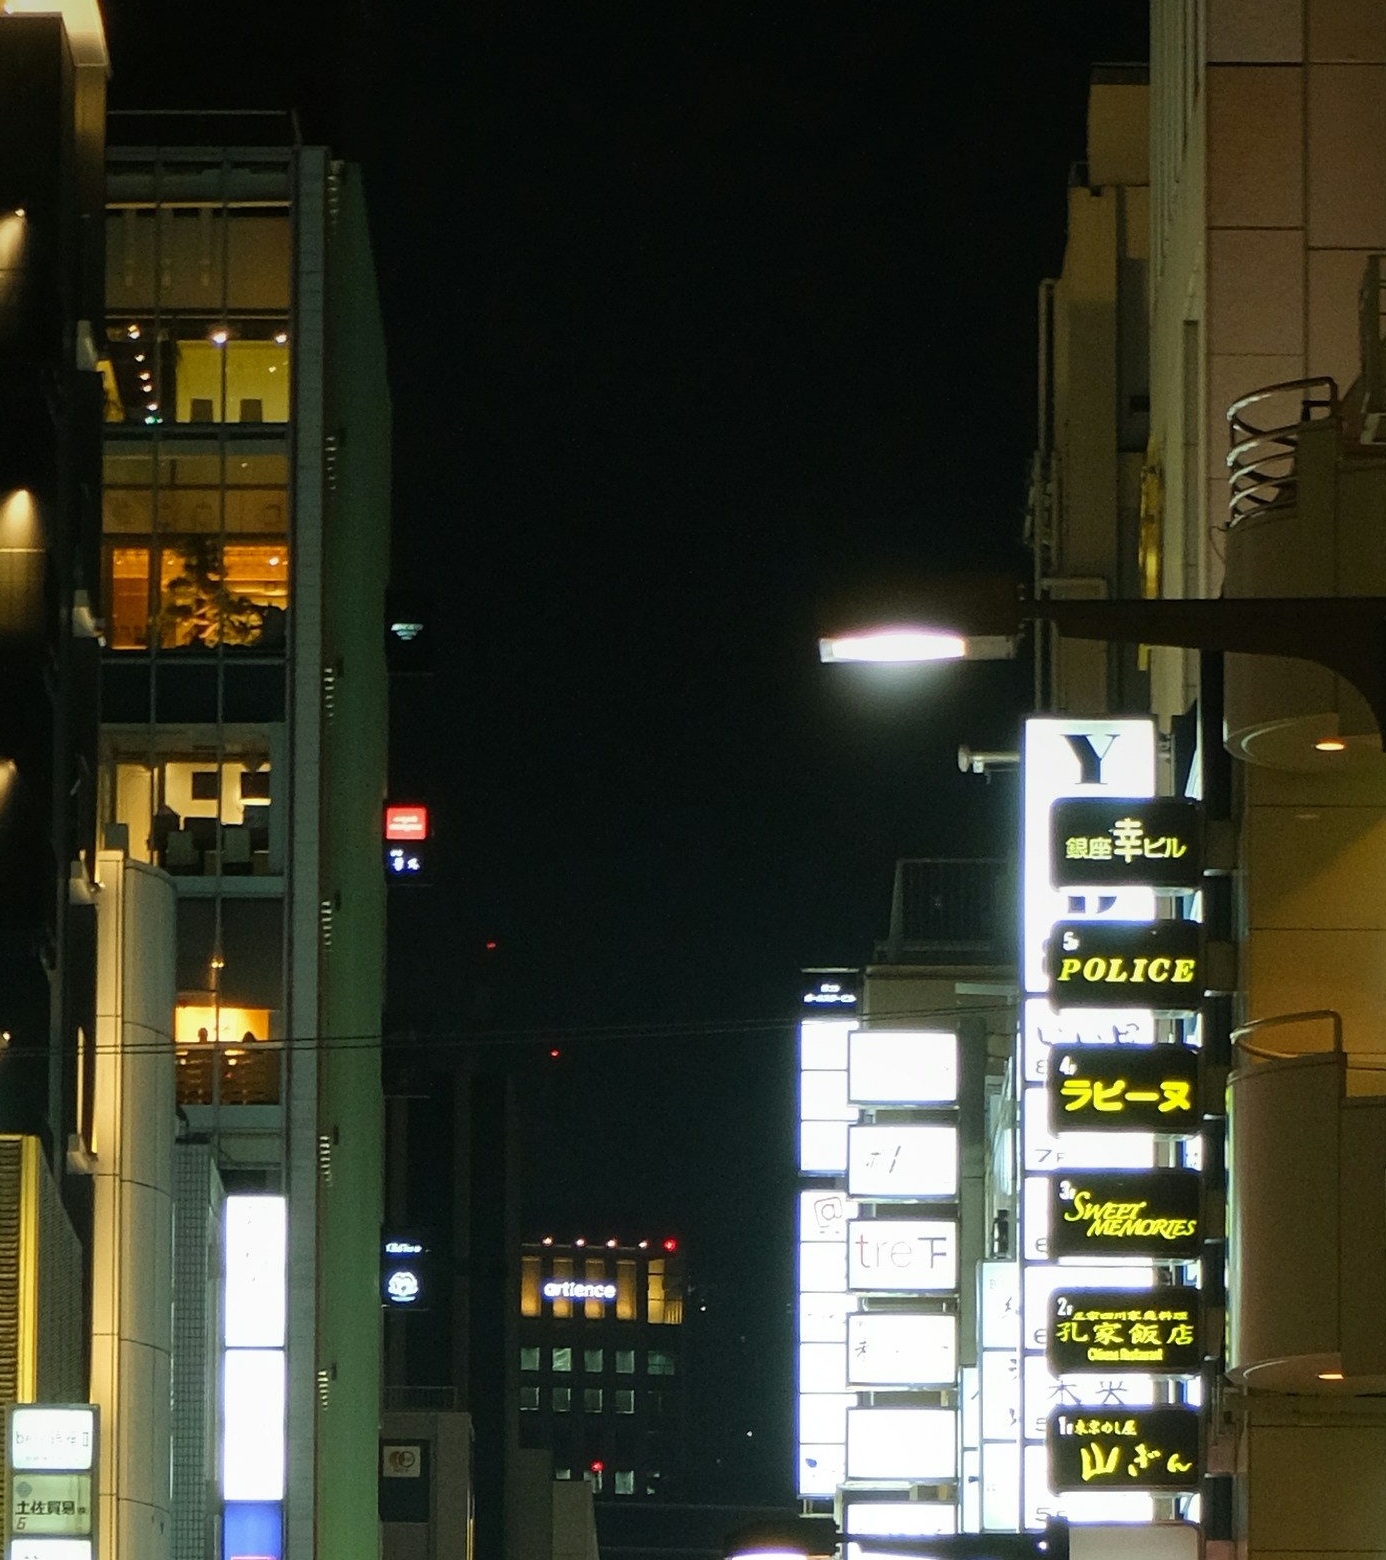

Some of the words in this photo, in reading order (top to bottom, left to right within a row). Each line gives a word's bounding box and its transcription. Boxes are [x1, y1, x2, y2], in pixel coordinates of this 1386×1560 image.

[1065, 818, 1187, 864] 銀座幸ビル
[1057, 957, 1196, 983] POLICE
[542, 1278, 617, 1302] artience
[1056, 1321, 1194, 1345] 孔家飯店
[1080, 1442, 1193, 1481] 山ぎん
